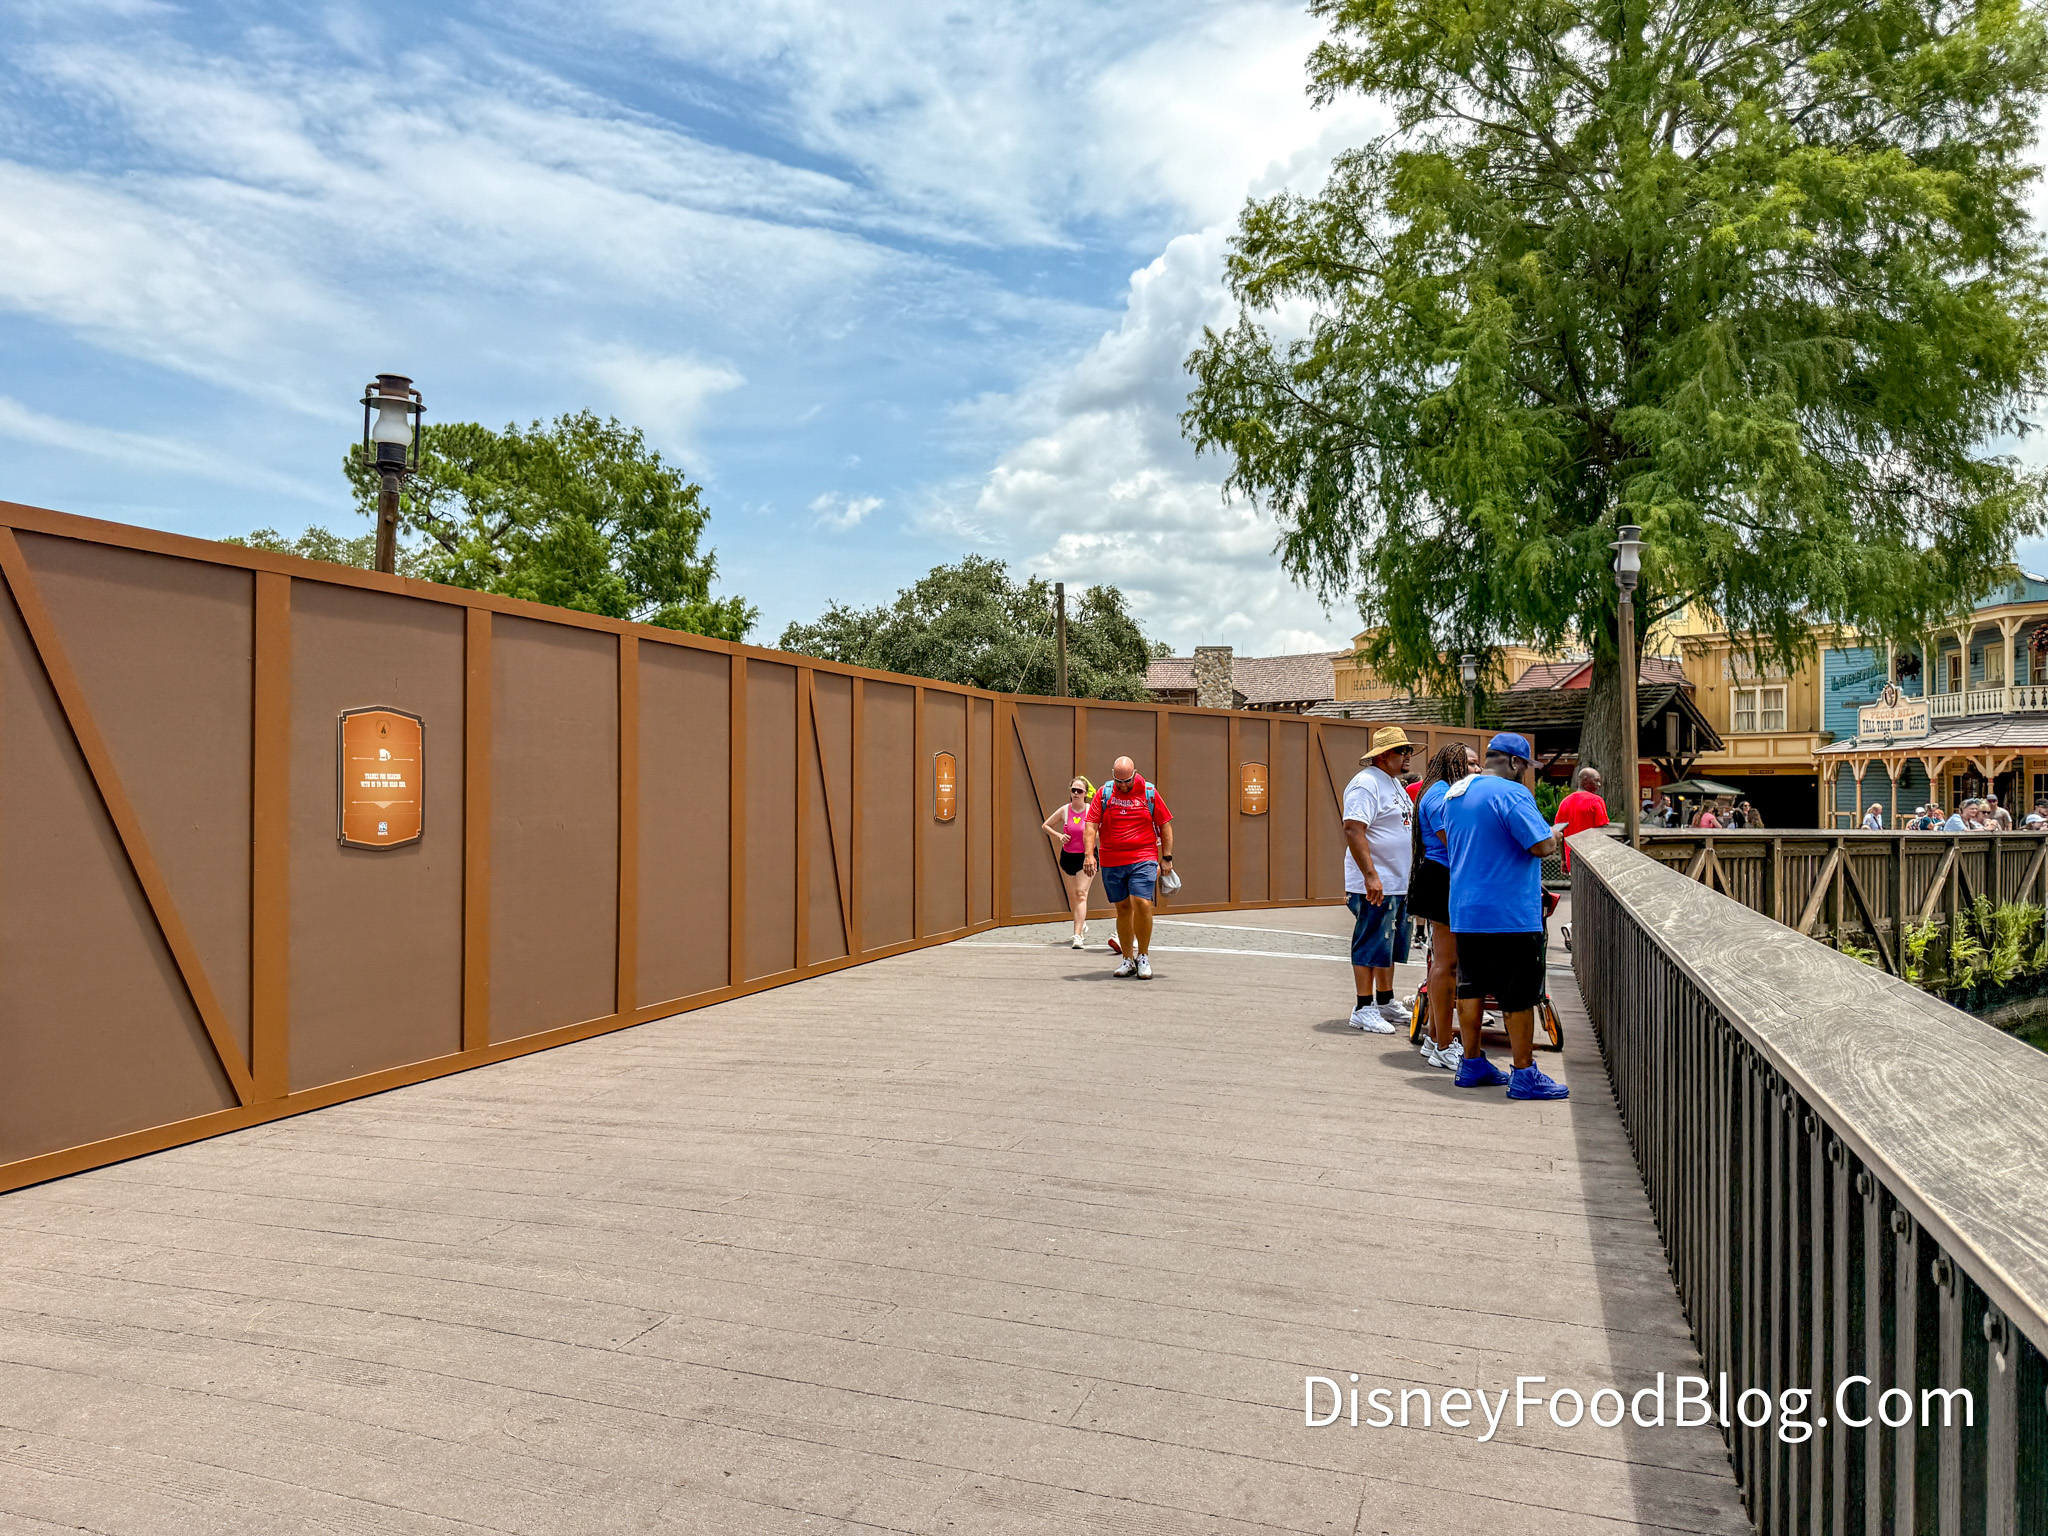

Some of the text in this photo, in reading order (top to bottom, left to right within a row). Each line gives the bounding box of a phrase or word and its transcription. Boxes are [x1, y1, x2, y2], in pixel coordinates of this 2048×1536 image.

[1870, 707, 1916, 720] PECOS BILL
[1862, 719, 1875, 733] TALL
[1876, 719, 1891, 732] TALE
[1892, 719, 1904, 732] INN
